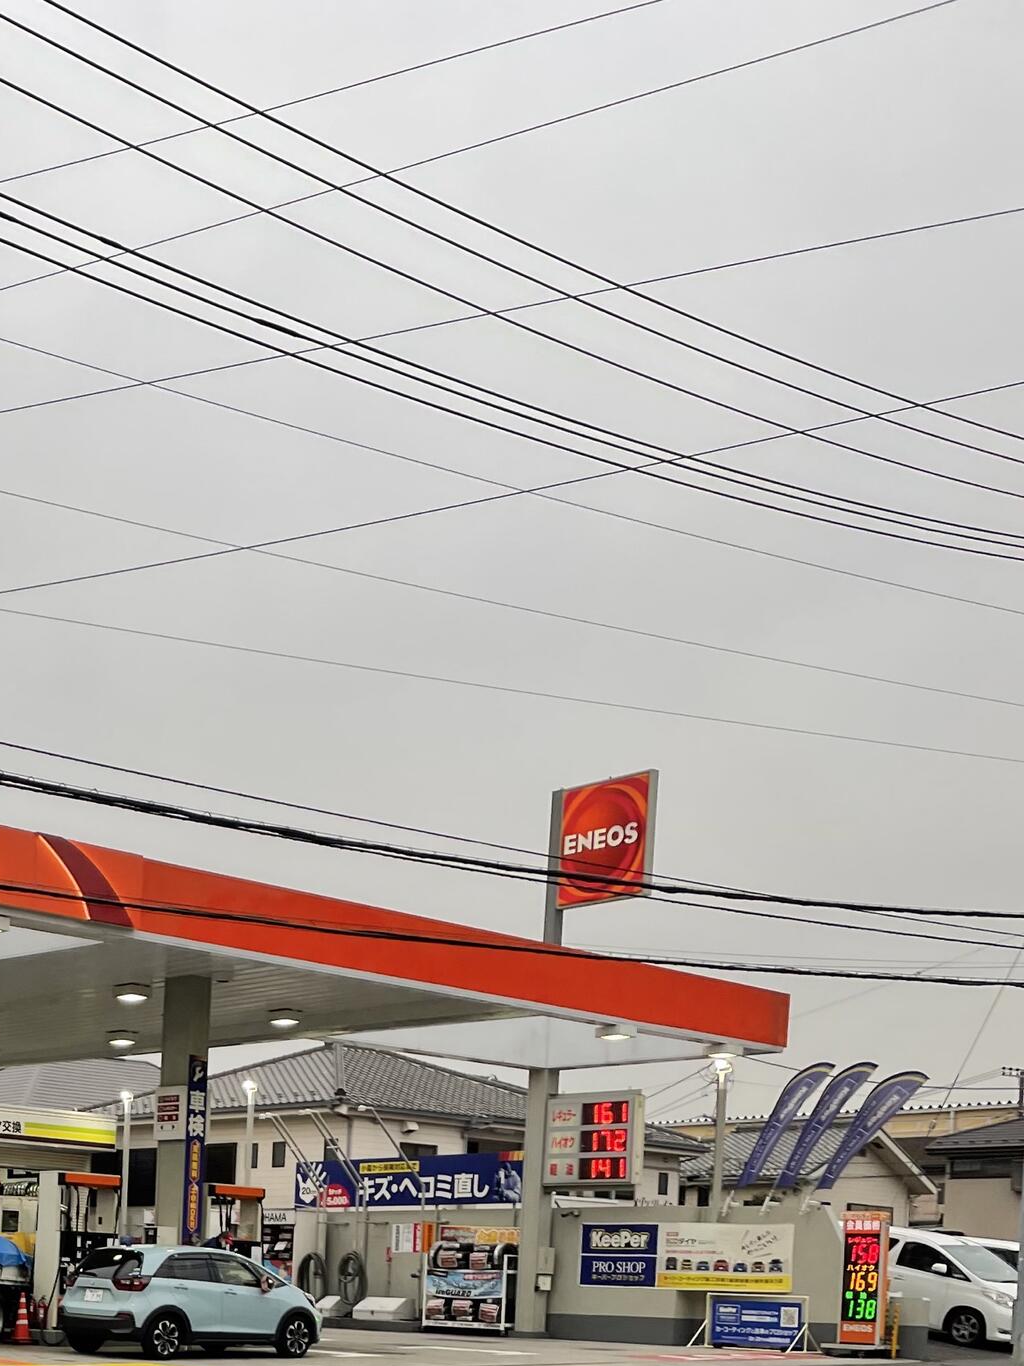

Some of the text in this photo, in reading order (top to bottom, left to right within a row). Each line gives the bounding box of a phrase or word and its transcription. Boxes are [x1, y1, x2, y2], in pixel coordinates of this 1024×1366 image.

[563, 821, 638, 856] ENEOS
[188, 1090, 206, 1138] 車検
[593, 1102, 628, 1124] 161
[592, 1130, 626, 1152] 172
[591, 1158, 625, 1178] 141
[358, 1173, 490, 1201] キズ・ヘコミ直し
[264, 1212, 287, 1222] HAMA
[590, 1229, 649, 1249] KeePer
[851, 1243, 880, 1264] 158
[592, 1260, 646, 1273] PRO SHOP
[846, 1264, 875, 1272] ハイオク
[849, 1272, 878, 1292] 169
[848, 1299, 877, 1319] 138
